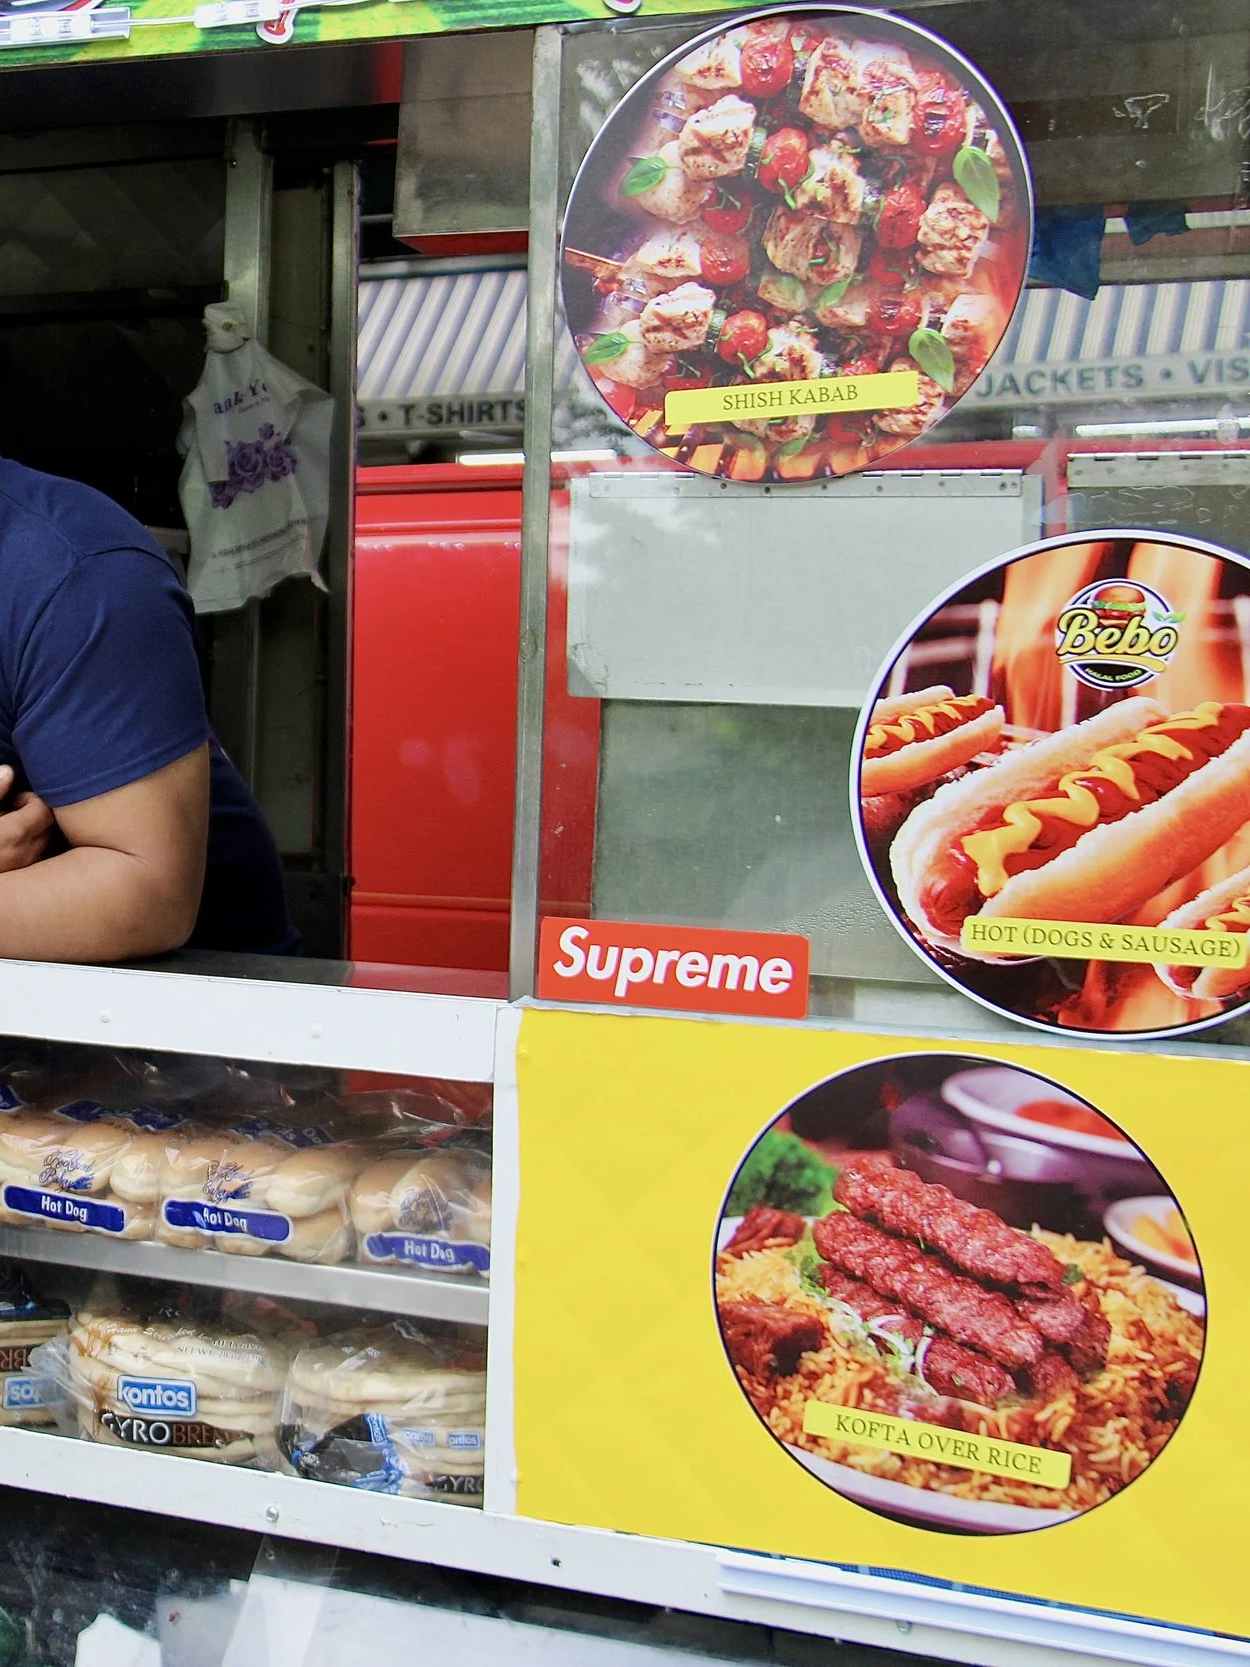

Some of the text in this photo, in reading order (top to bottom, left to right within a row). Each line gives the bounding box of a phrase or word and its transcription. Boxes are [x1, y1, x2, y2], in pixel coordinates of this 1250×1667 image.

[974, 363, 1144, 398] JACKETS
[724, 384, 858, 411] SHISH KABAB
[1056, 606, 1178, 657] Bebo
[1085, 667, 1143, 681] HALAL FOOD
[971, 924, 1241, 958] HOT (DOGS & SAUSAGE)
[553, 926, 794, 997] Supreme
[41, 1195, 87, 1222] Hot Dog
[224, 1211, 247, 1232] Dog
[404, 1240, 454, 1262] Hot Dog
[118, 1384, 189, 1408] kontos
[835, 1413, 1041, 1475] KOFTA OVER RICE
